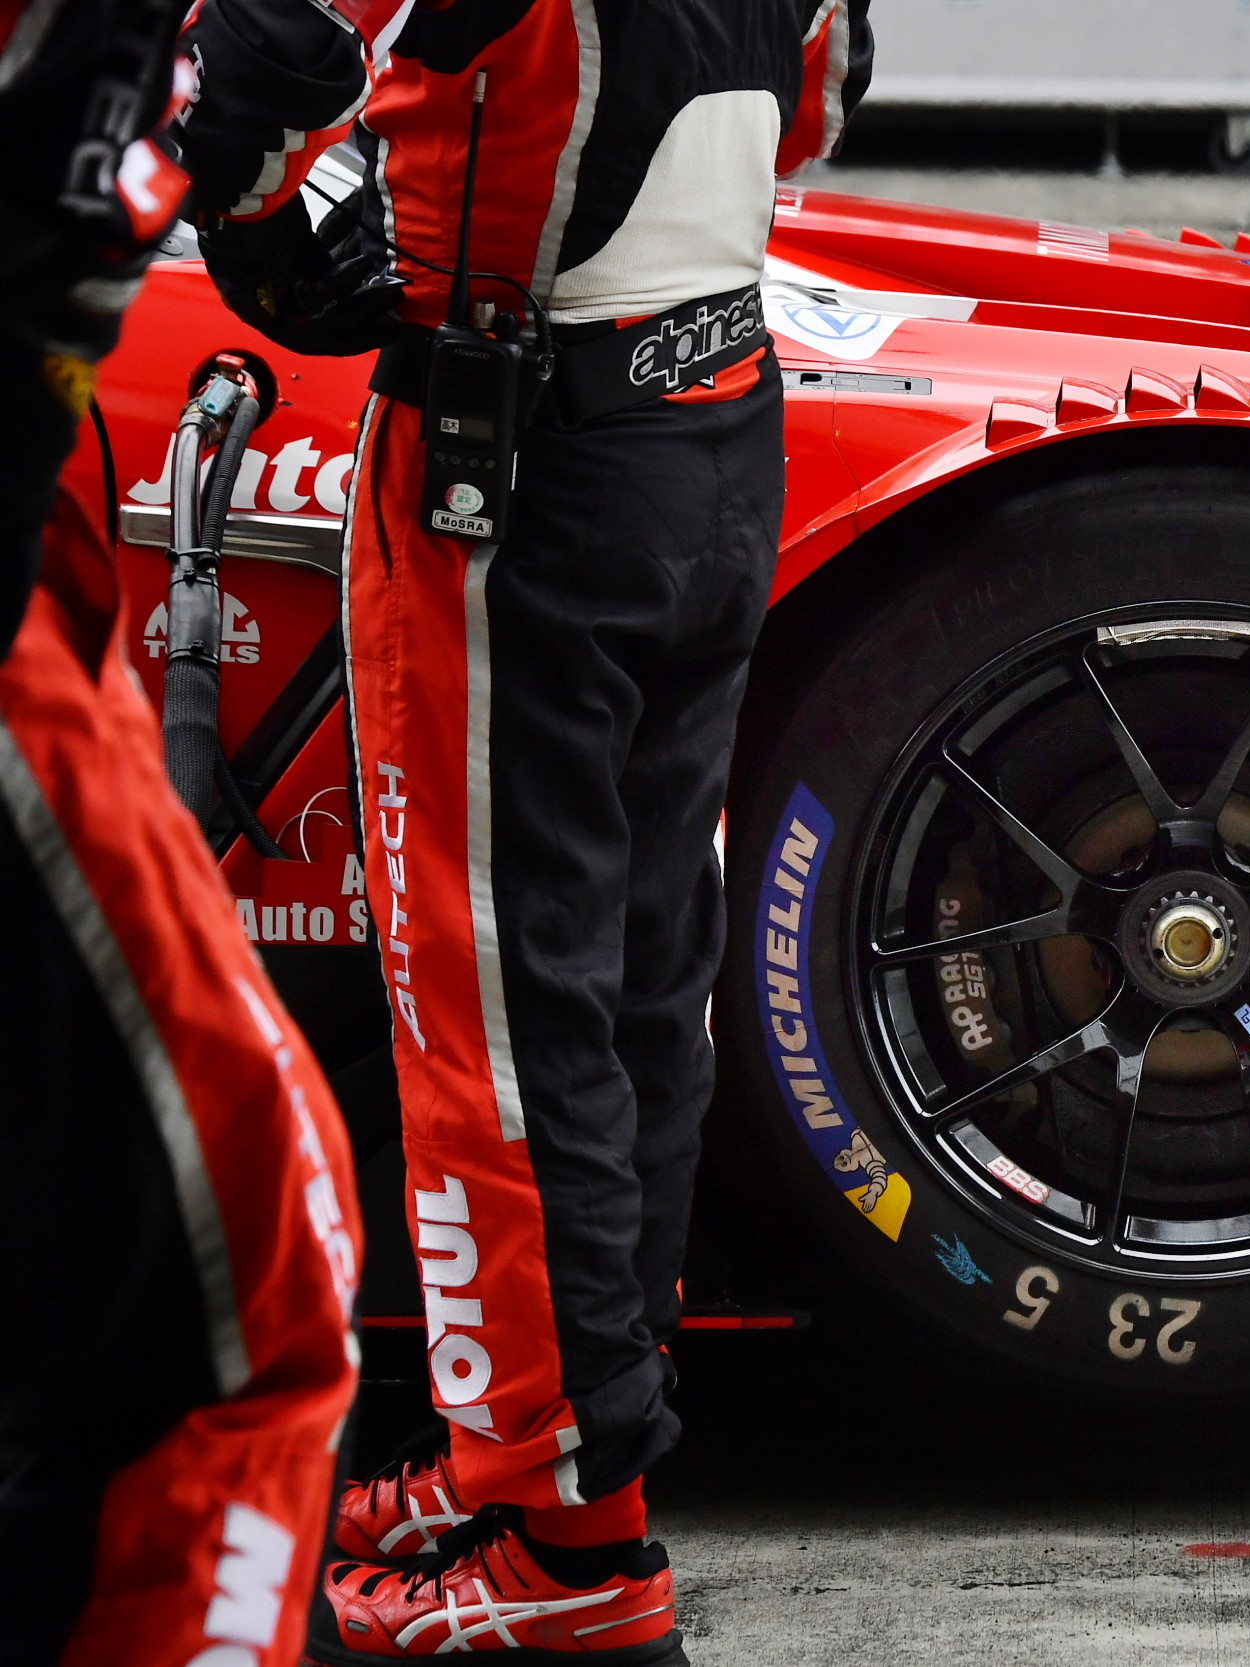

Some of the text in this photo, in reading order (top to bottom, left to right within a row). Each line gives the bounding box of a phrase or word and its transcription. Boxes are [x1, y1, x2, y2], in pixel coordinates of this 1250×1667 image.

[440, 515, 485, 533] MoSRA
[143, 639, 261, 664] TLS
[236, 898, 335, 942] Auto
[377, 761, 426, 1053] AUTECH
[770, 817, 844, 1130] MICHELIN
[986, 1155, 1049, 1204] BBS
[1002, 1266, 1201, 1364] 23 5
